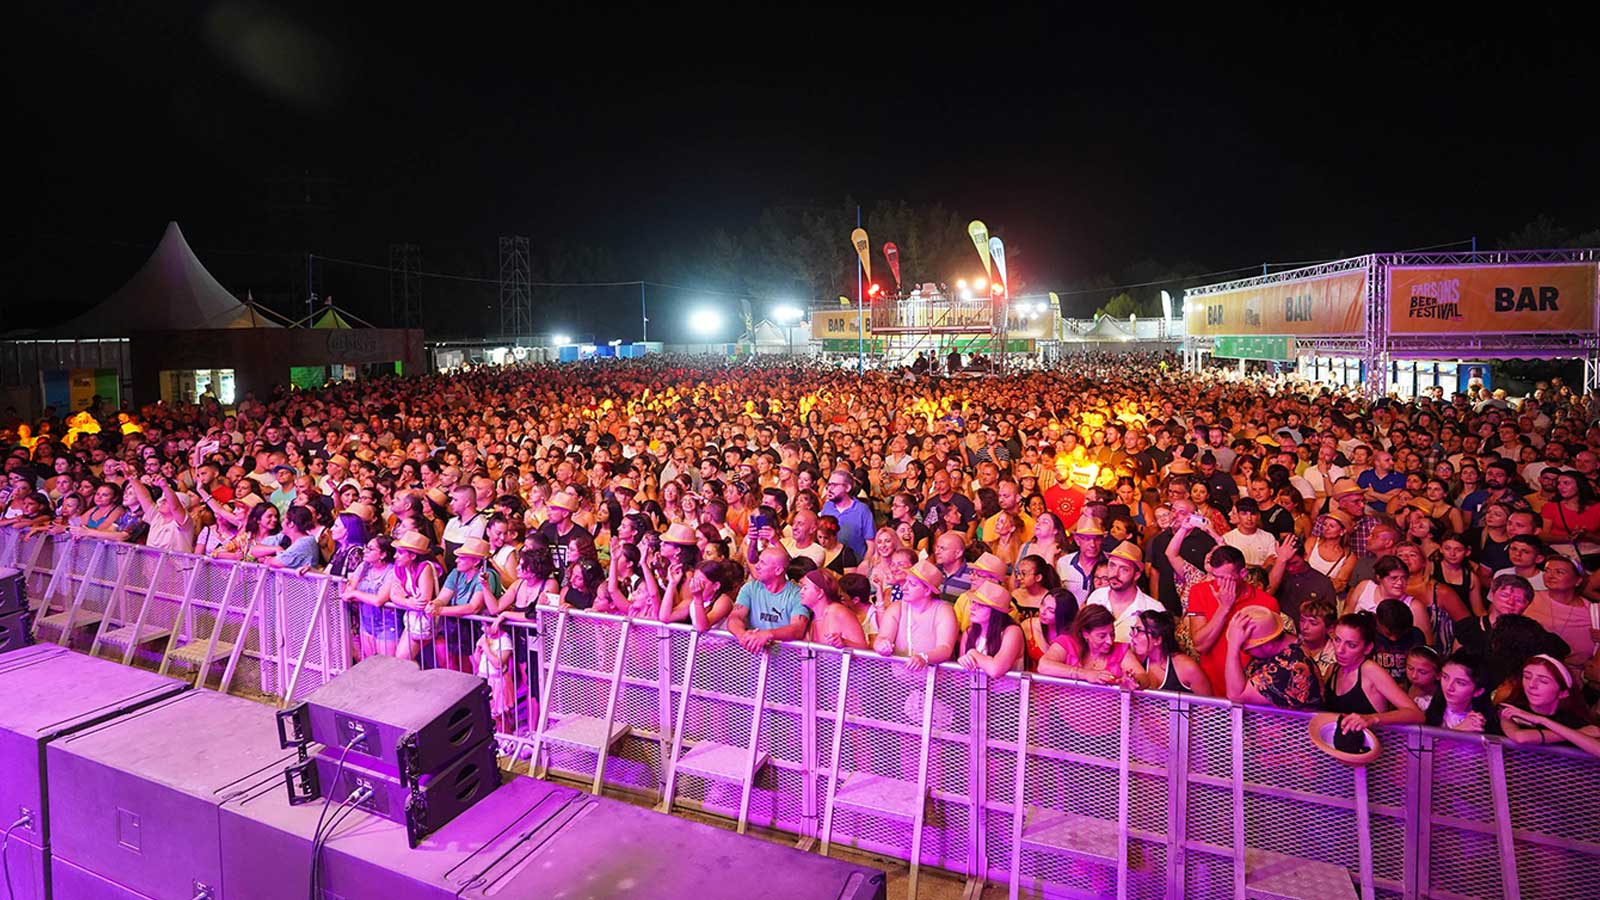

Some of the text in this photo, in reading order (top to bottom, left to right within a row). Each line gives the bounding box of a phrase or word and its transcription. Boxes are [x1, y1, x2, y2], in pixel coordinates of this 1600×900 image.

[1410, 295, 1437, 308] BEER
[1411, 278, 1460, 304] FARSONS
[1495, 286, 1560, 312] BAR
[1208, 304, 1224, 325] BAR
[1285, 296, 1312, 322] BAR
[1408, 303, 1463, 320] FESTIVAL
[828, 318, 845, 332] BAR
